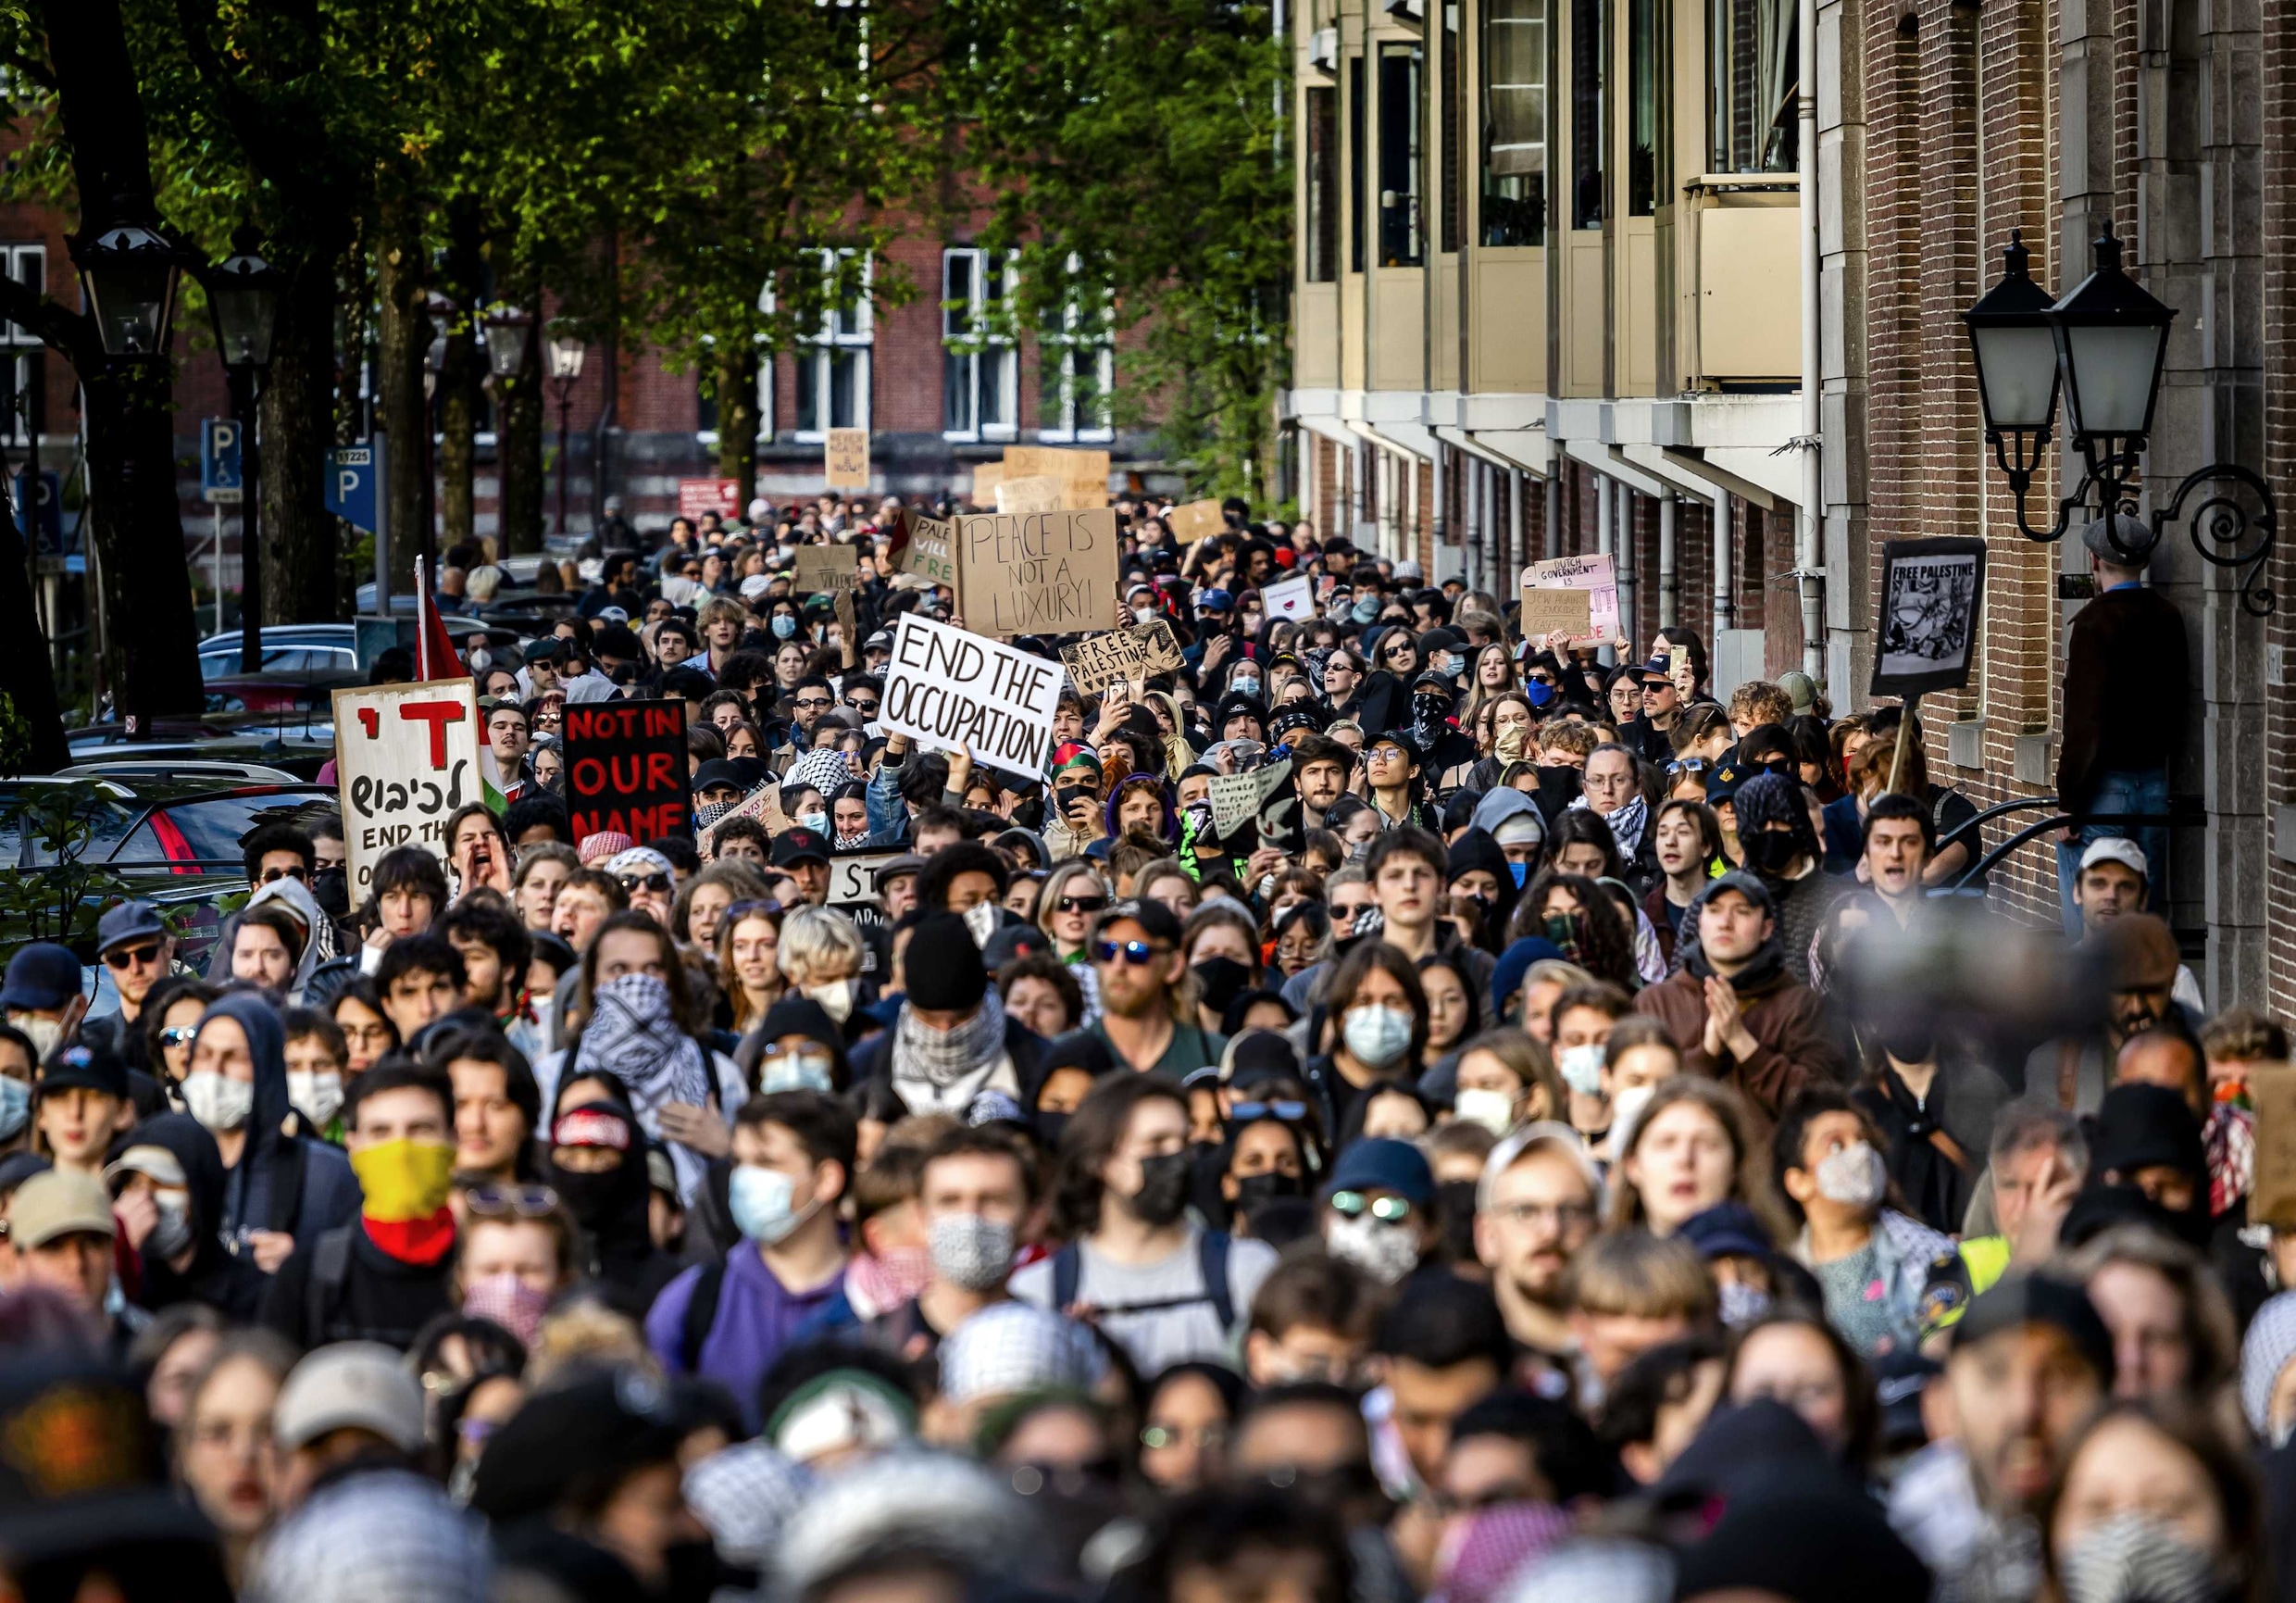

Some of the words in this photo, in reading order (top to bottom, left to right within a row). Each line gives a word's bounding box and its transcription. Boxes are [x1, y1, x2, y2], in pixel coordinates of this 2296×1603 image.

[214, 425, 234, 460] P
[339, 470, 360, 504] P
[917, 520, 952, 541] PALE
[965, 513, 1054, 564] PEACE
[1067, 514, 1093, 553] IS
[914, 537, 948, 557] WILL
[913, 555, 953, 581] FRE
[1009, 558, 1049, 588] NOT
[1055, 557, 1073, 584] A
[1541, 564, 1598, 580] GOVERNMENT
[1554, 557, 1581, 570] DUTCH
[1892, 566, 1918, 581] FREE
[1920, 562, 1975, 579] PALESTINE
[1564, 577, 1573, 586] IS
[993, 578, 1092, 632] LUXURY!
[1527, 592, 1552, 605] JEW
[1555, 592, 1588, 605] AGAINST
[1079, 632, 1130, 660] FREE
[898, 622, 984, 683] END
[990, 650, 1054, 714] THE
[1070, 643, 1148, 683] PALESTINE
[567, 708, 638, 741] NOT
[643, 707, 680, 738] IN
[887, 674, 1046, 770] OCCUPATION
[351, 759, 468, 819] לכיבוש
[572, 752, 679, 796] OUR
[363, 823, 412, 850] END
[418, 820, 446, 843] TH
[843, 863, 878, 898] ST
